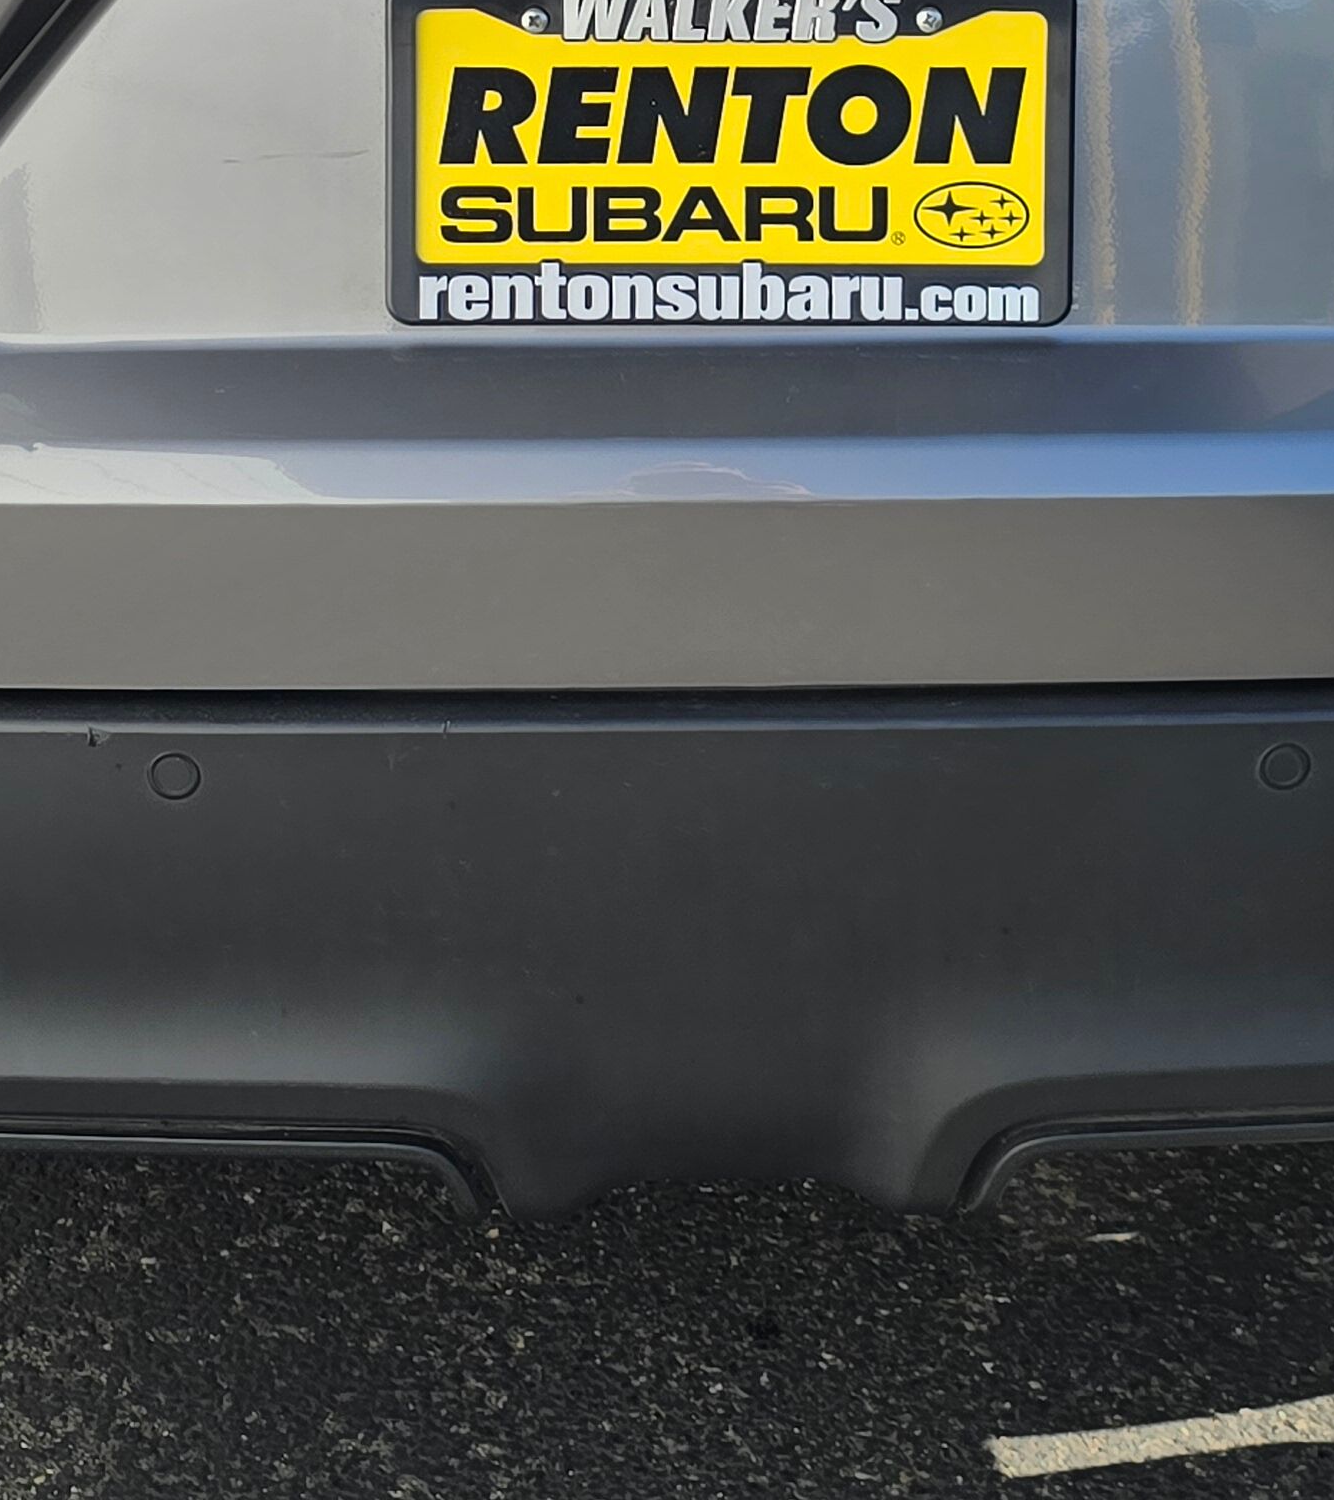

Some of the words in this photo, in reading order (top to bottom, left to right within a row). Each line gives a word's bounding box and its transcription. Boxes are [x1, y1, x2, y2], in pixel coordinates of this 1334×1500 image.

[439, 65, 1027, 166] RENTON
[440, 185, 890, 243] SUBARU
[419, 263, 1040, 322] rentonsubaru.com
